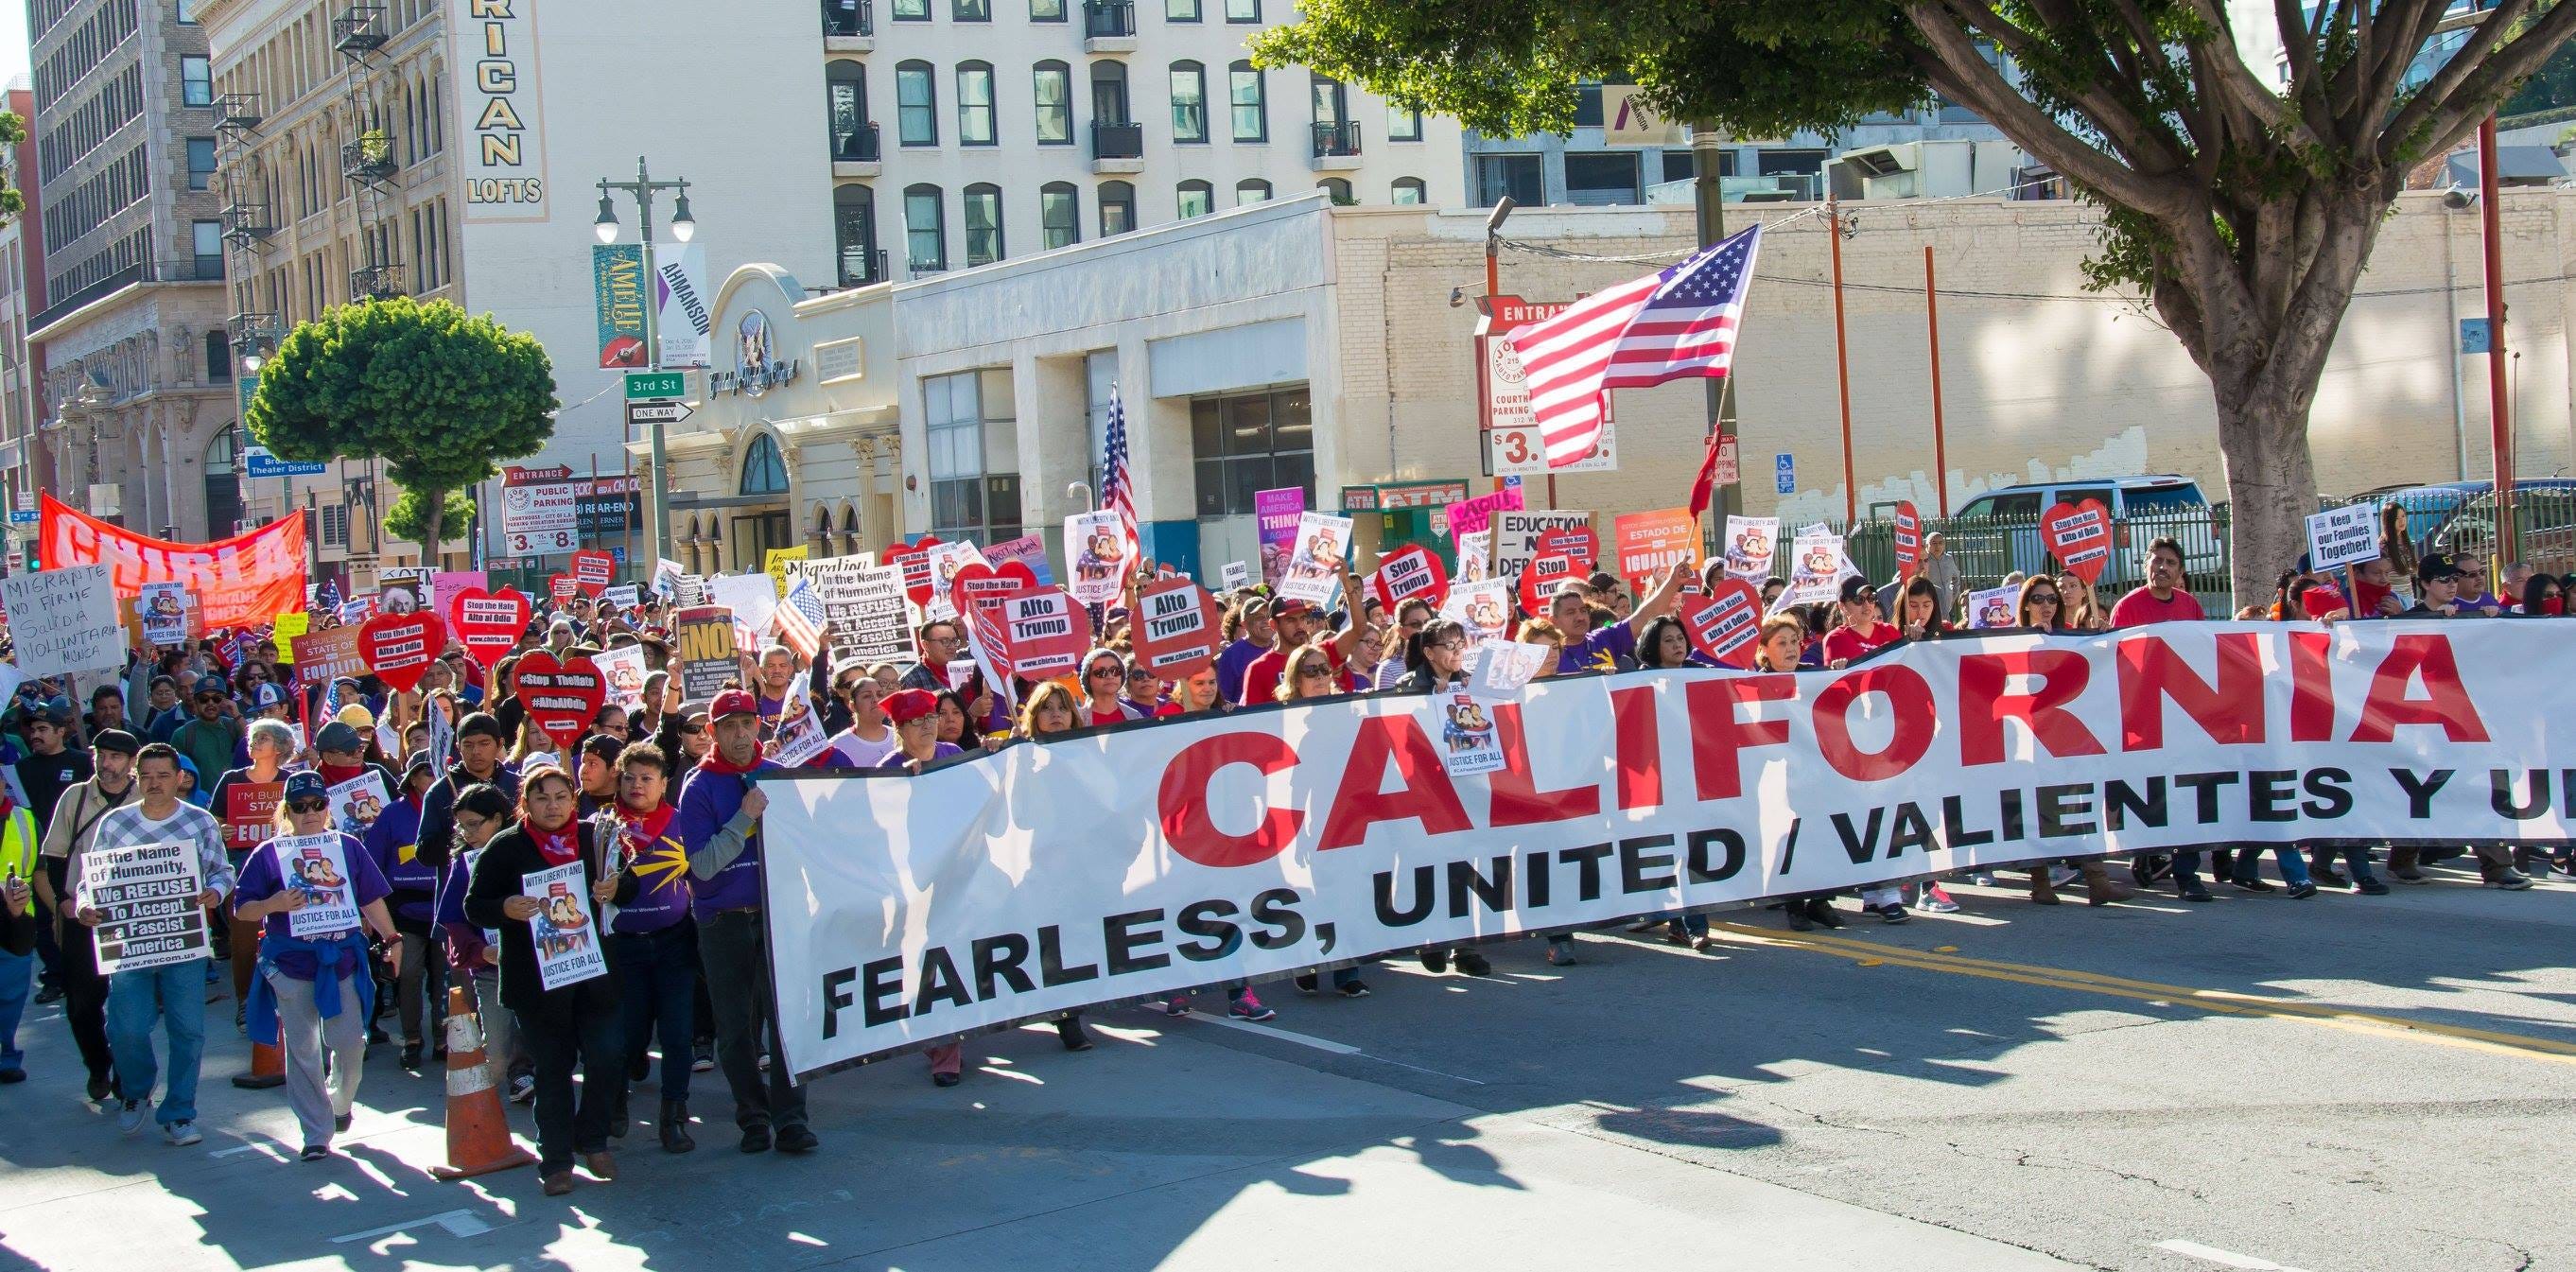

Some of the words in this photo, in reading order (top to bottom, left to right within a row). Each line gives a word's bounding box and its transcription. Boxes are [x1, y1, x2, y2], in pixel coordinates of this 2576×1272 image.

[467, 178, 542, 203] LOFTS
[662, 262, 709, 337] AHMANSON
[634, 381, 654, 392] 3rd
[663, 380, 676, 390] St
[1496, 395, 1529, 404] COURTH
[635, 409, 654, 418] ONE
[1493, 405, 1529, 415] PARKING
[289, 463, 322, 472] District
[513, 469, 563, 479] ENTRANCE
[536, 487, 568, 496] PUBLIC
[1267, 493, 1293, 502] MAKE
[1388, 488, 1465, 507] ATM
[533, 497, 573, 507] PARKING
[1262, 503, 1300, 514] AMERICA
[1346, 497, 1374, 509] ATM
[1262, 514, 1301, 530] THINK
[1506, 516, 1588, 532] EDUCATION
[2331, 514, 2351, 528] Keep
[1630, 526, 1670, 540] ESTADO
[1673, 524, 1687, 533] DE
[2062, 531, 2077, 543] Alto
[2078, 531, 2083, 539] al
[2084, 527, 2099, 538] Odio
[2318, 533, 2332, 545] our
[2334, 525, 2370, 540] Families
[56, 514, 297, 594] CHIRLA
[2320, 538, 2372, 560] Together!
[896, 554, 910, 564] Stop
[1538, 559, 1566, 575] Stop
[1390, 557, 1419, 578] Stop
[8, 566, 106, 598] MIGRANTE
[823, 575, 834, 584] In
[835, 573, 854, 584] the
[858, 570, 891, 581] Name
[607, 588, 635, 597] Valientes
[825, 588, 834, 600] of
[838, 584, 896, 599] Humanity,
[967, 582, 984, 590] Stop
[1392, 573, 1429, 598] Trump
[1453, 586, 1469, 596] WITH
[1470, 583, 1492, 593] LIBERTY
[1492, 581, 1505, 590] AND
[11, 602, 28, 619] NO
[498, 601, 514, 610] Hate
[828, 605, 847, 618] We
[849, 598, 902, 615] REFUSE
[1020, 599, 1053, 618] Alto
[1155, 594, 1187, 616] Alto
[1697, 611, 1714, 624] Stop
[1714, 605, 1725, 617] the
[1726, 595, 1743, 608] Hate
[468, 614, 482, 622] Alto
[494, 614, 511, 622] Odio
[837, 620, 851, 633] To
[855, 614, 898, 631] Accept
[1151, 612, 1199, 637] Trump
[1016, 619, 1066, 637] Trump
[1708, 627, 1724, 641] Alto
[1725, 621, 1732, 633] al
[1732, 612, 1749, 626] Odio
[23, 626, 117, 662] VOLUNTARIA
[311, 634, 354, 647] BUILDING
[853, 630, 898, 644] Fascist
[306, 645, 338, 656] STATE
[340, 641, 355, 651] OF
[849, 644, 898, 656] America
[303, 658, 365, 681] EQUALITY
[520, 674, 549, 687] #Stop
[1157, 631, 2492, 868] CALIFORNIA
[1449, 755, 1473, 766] JUSTICE
[1474, 753, 1488, 763] FOR
[1489, 751, 1503, 760] ALL
[237, 792, 254, 801] I'M
[258, 791, 283, 799] BUIL
[275, 838, 293, 848] WITH
[295, 836, 321, 847] LIBERTY
[323, 833, 339, 843] AND
[88, 856, 101, 866] In
[108, 851, 132, 863] the
[137, 845, 181, 861] Name
[91, 868, 106, 882] of
[111, 861, 187, 880] Humanity,
[525, 877, 543, 888] WITH
[544, 868, 567, 883] LIBERTY
[568, 864, 583, 876] AND
[97, 889, 122, 903] We
[125, 879, 191, 899] REFUSE
[108, 906, 128, 921] To
[132, 898, 186, 919] Accept
[823, 887, 1335, 1040] FEARLESS,
[1373, 826, 1748, 929] UNITED
[1780, 817, 1801, 877] /
[1830, 767, 2354, 865] VALIENTES
[2390, 768, 2457, 819] Y
[292, 913, 324, 925] JUSTICE
[326, 911, 340, 921] FOR
[342, 909, 357, 918] ALL
[114, 927, 125, 938] a
[130, 916, 186, 936] Fascist
[297, 921, 353, 932] #CAFearlessUnited
[122, 937, 185, 957] America
[114, 952, 197, 970] www.revcom.us
[543, 962, 569, 978] JUSTICE
[571, 957, 586, 970] FOR
[587, 951, 602, 966] ALL
[548, 967, 599, 985] #CAFearlessUnited
